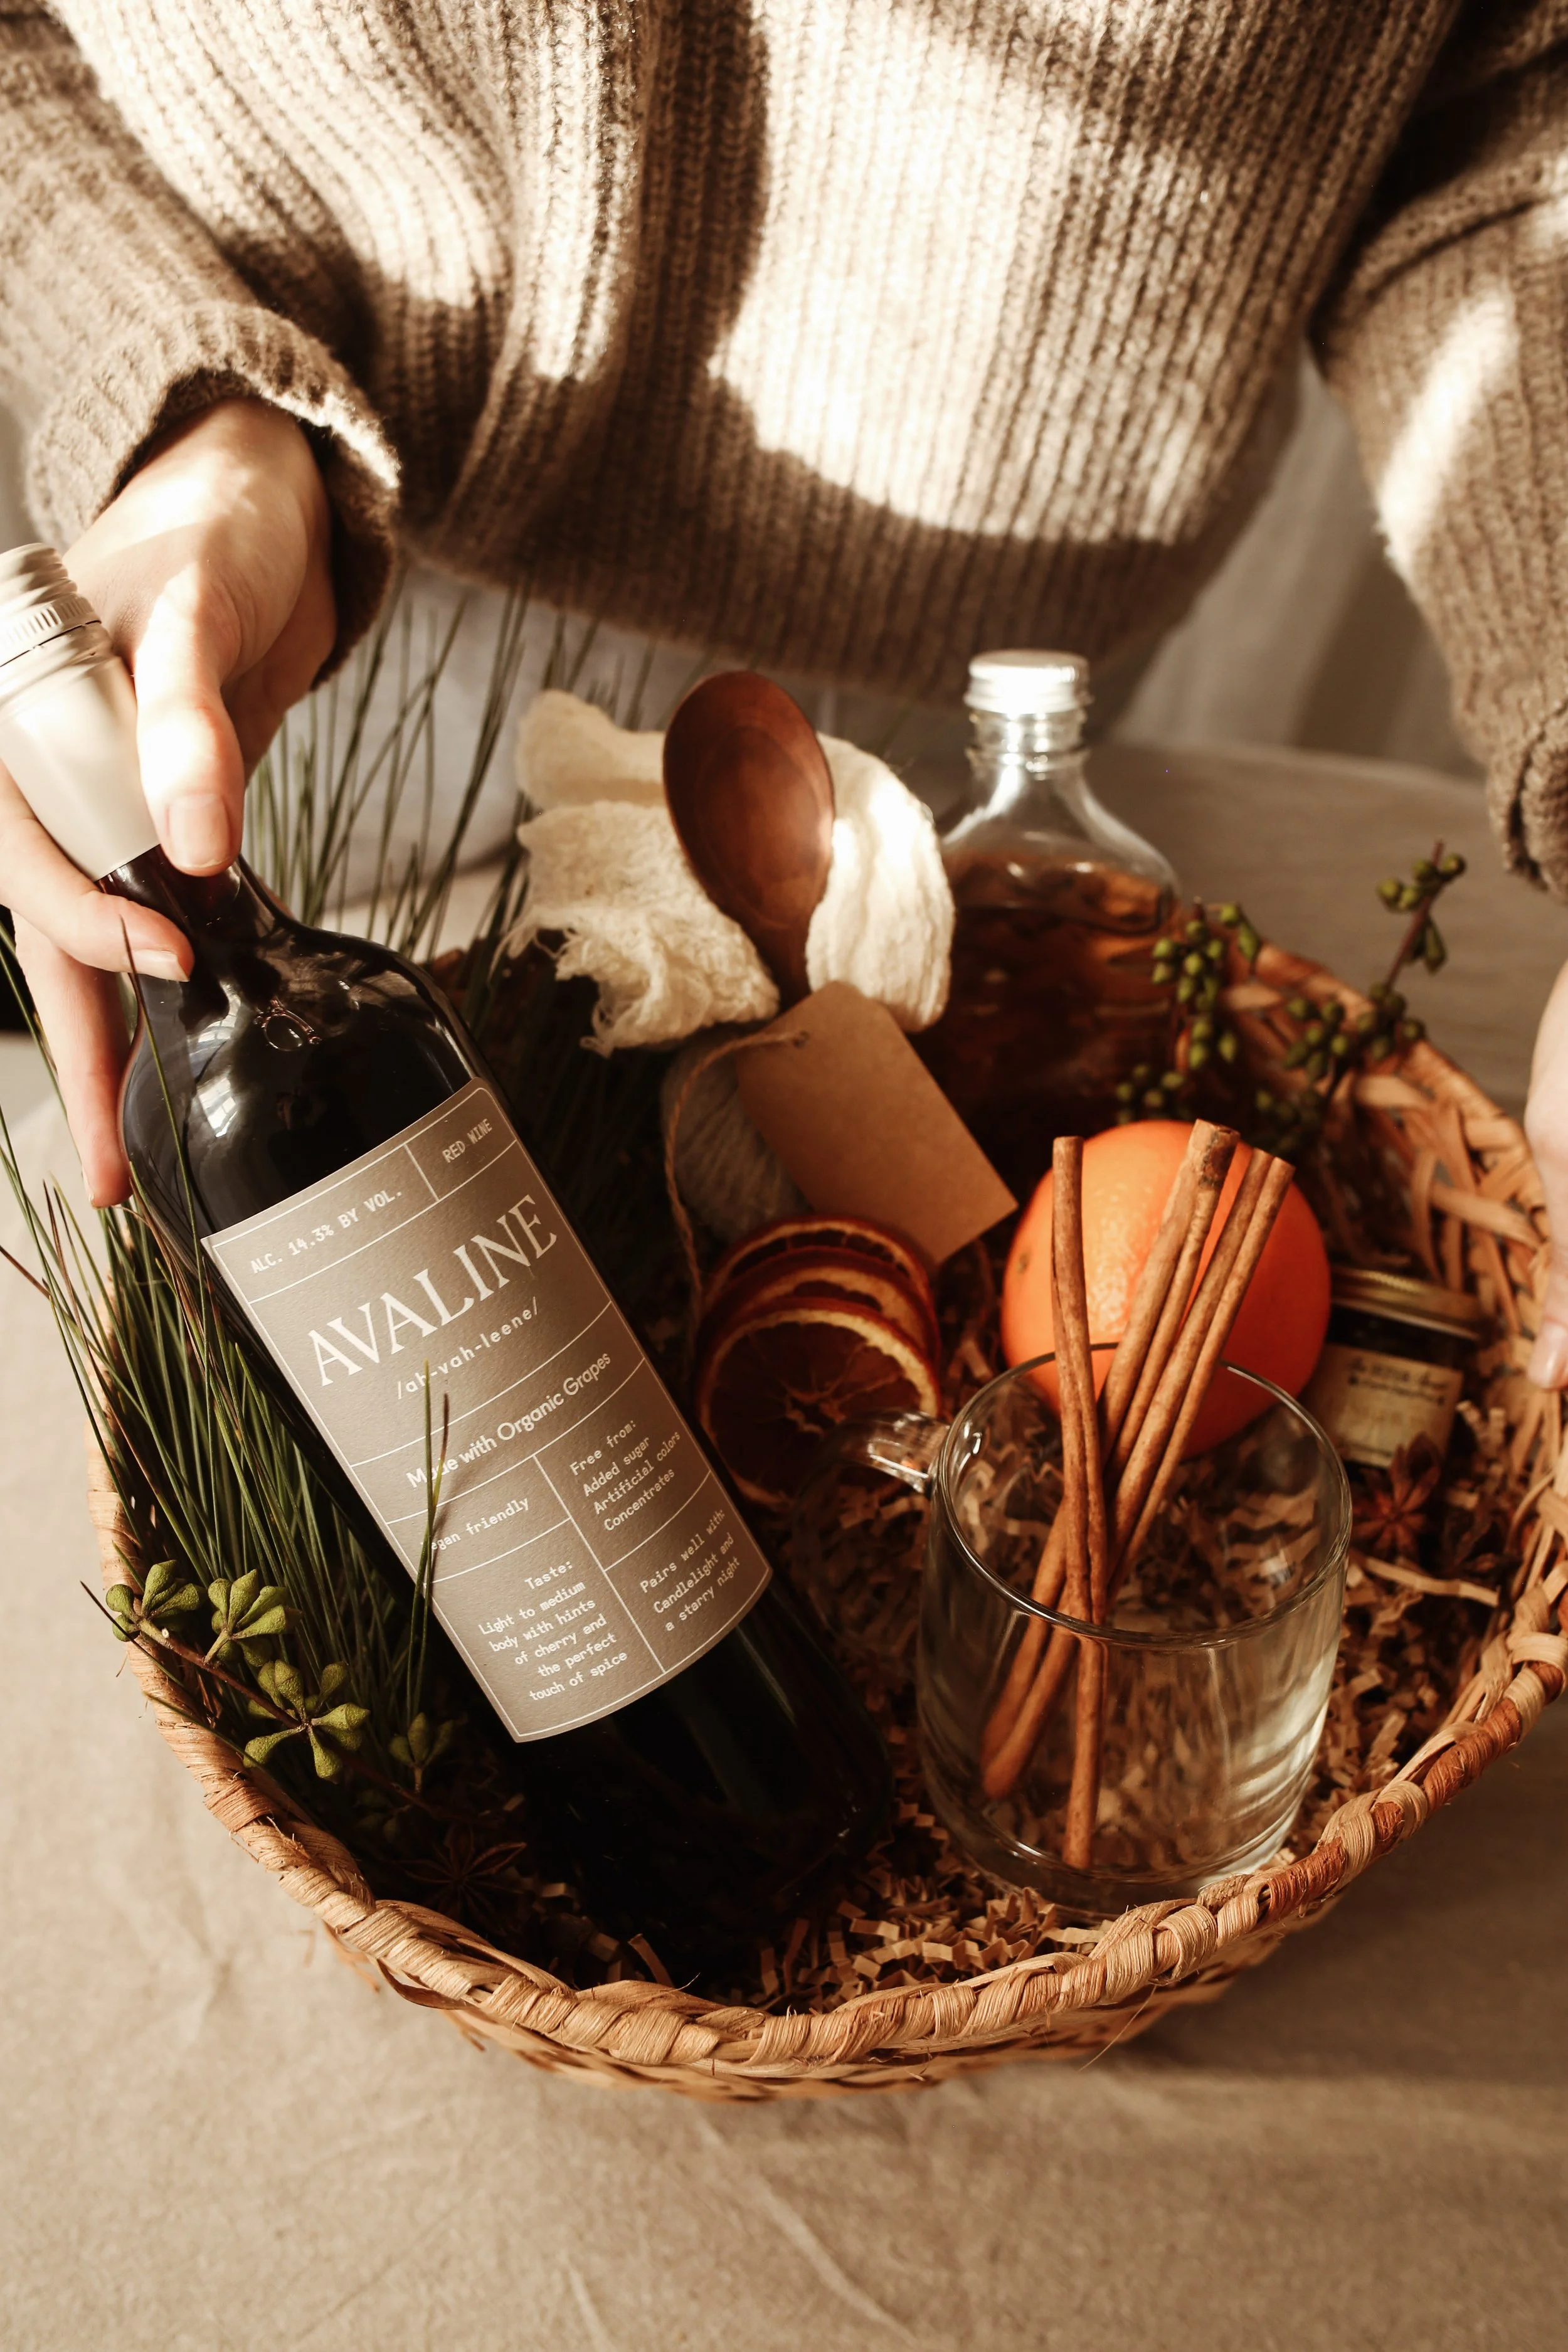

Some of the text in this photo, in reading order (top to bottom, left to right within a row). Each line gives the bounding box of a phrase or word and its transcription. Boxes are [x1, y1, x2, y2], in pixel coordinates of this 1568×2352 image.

[442, 1118, 493, 1163] RED WINE
[250, 1190, 402, 1274] ALC. 14.3% BY VOL.
[308, 1194, 558, 1387] AVALINE
[458, 1434, 497, 1466] with
[496, 1392, 564, 1441] Organic
[563, 1353, 611, 1396] Grapes
[569, 1420, 637, 1476] Free from:
[583, 1437, 650, 1497] Added sugar
[593, 1431, 681, 1515] Artificial colors
[465, 1497, 529, 1535] friendly
[603, 1468, 675, 1532] Concentrates
[524, 1560, 573, 1589] Taste:
[640, 1509, 725, 1593] Pairs well with:
[654, 1532, 734, 1613] Candlelight and
[478, 1581, 586, 1635] Light to medium
[665, 1556, 740, 1631] a starry night
[489, 1599, 596, 1652] body with hints
[514, 1613, 607, 1665] of cherry and
[538, 1632, 617, 1677] the perfect
[529, 1651, 628, 1701] touch of spice
